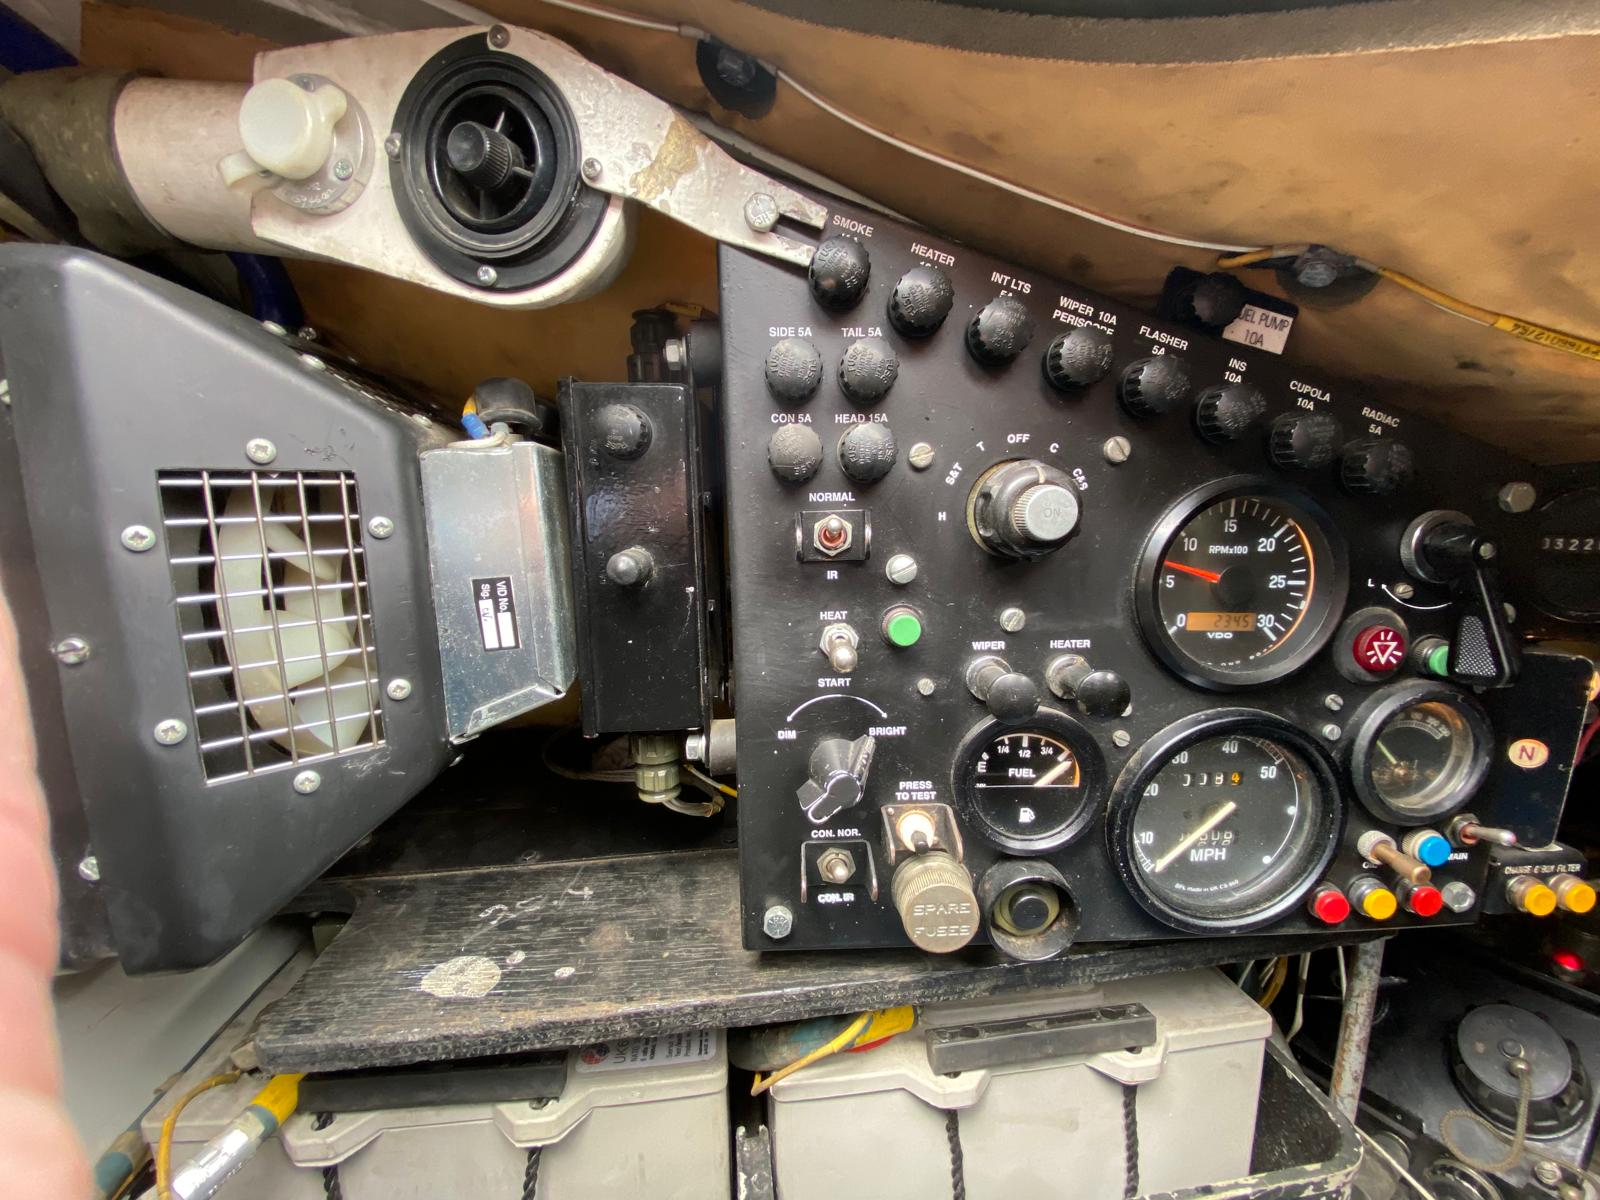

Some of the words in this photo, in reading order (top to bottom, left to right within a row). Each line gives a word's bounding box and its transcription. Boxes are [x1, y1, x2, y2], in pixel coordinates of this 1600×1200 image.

[832, 214, 874, 238] SMOKE
[911, 242, 956, 267] HEATER
[991, 271, 1011, 286] INT
[1011, 278, 1032, 294] LTS
[1059, 295, 1094, 317] WIPER
[1099, 311, 1118, 326] 10A
[1052, 309, 1115, 336] PERISCE
[1239, 308, 1256, 324] UEL
[1260, 311, 1290, 332] PUMP
[769, 326, 795, 337] SIDE
[798, 326, 812, 337] 5A
[841, 327, 865, 337] TAIL
[868, 327, 883, 337] 5A
[1139, 325, 1189, 350] FLASHER
[1244, 329, 1264, 347] 10A
[1152, 345, 1166, 356] 5A
[1228, 357, 1247, 372] INS
[1224, 371, 1242, 384] 10A
[1289, 380, 1331, 403] CUPOLA
[1296, 397, 1315, 411] 10A
[770, 413, 795, 424] CON
[798, 413, 812, 423] 5A
[834, 413, 866, 424] HEAD
[868, 413, 888, 423] 15A
[1361, 406, 1400, 428] RADIAC
[1368, 424, 1382, 436] 5A
[1007, 434, 1030, 444] OFF
[976, 441, 985, 451] T
[1050, 443, 1059, 453] C
[945, 462, 963, 485] S&T
[1072, 468, 1088, 491] C&S
[808, 492, 856, 502] NORMAL
[938, 512, 946, 520] H
[1224, 519, 1238, 533] 15
[1183, 537, 1198, 552] 10
[1208, 545, 1248, 554] RPMx100
[1257, 537, 1276, 552] 20
[1542, 538, 1600, 551] 322
[827, 570, 838, 580] IR
[496, 580, 507, 597] VID
[1165, 575, 1175, 589] 5
[1268, 575, 1286, 589] 25
[1367, 578, 1375, 587] L
[498, 597, 509, 613] No.
[820, 611, 847, 620] HEAT
[1176, 613, 1186, 627] 0
[1214, 614, 1250, 628] 2345
[1257, 613, 1275, 628] 30
[1207, 631, 1233, 639] VDO
[972, 641, 1006, 650] WIPER
[1050, 639, 1091, 649] HEATER
[817, 678, 851, 687] START
[777, 730, 797, 740] DIM
[869, 726, 907, 736] BRIGHT
[997, 745, 1010, 754] 1/4
[1040, 747, 1053, 755] 3/4
[1222, 740, 1238, 754] 40
[1518, 745, 1536, 761] N
[1018, 750, 1031, 758] 1/2
[1172, 751, 1188, 764] 30
[977, 761, 987, 773] E
[1008, 768, 1036, 778] FUEL
[1260, 766, 1277, 779] 50
[899, 781, 932, 790] PRESS
[1143, 784, 1159, 797] 20
[896, 791, 910, 801] TO
[911, 791, 937, 800] TEST
[811, 829, 836, 838] CON.
[837, 828, 861, 837] NOR.
[1140, 831, 1153, 844] 10
[1190, 848, 1226, 862] MPH
[913, 903, 971, 916] SPARE
[913, 925, 971, 938] FUSES
